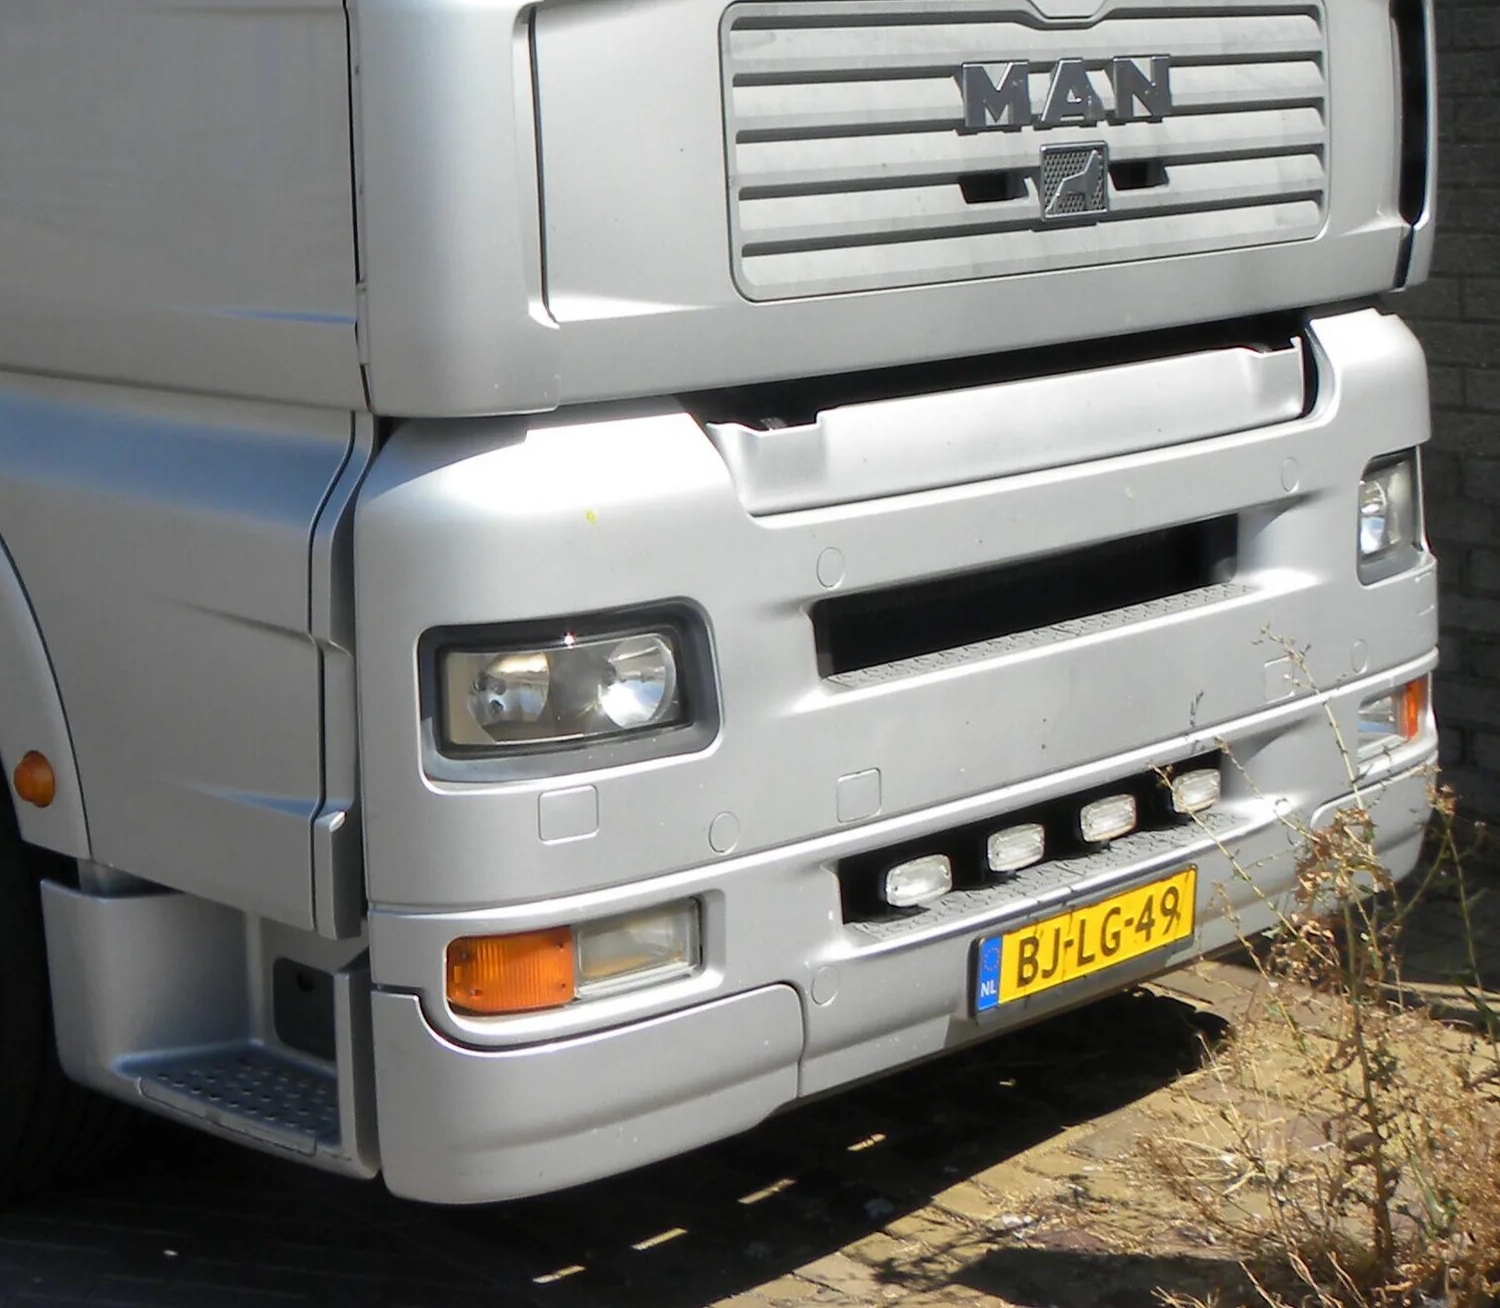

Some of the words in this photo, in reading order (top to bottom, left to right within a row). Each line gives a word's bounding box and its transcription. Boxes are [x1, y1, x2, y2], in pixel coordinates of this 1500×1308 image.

[962, 53, 1173, 128] MAN
[1016, 886, 1182, 989] BJ-LG-49
[980, 979, 998, 998] NL
